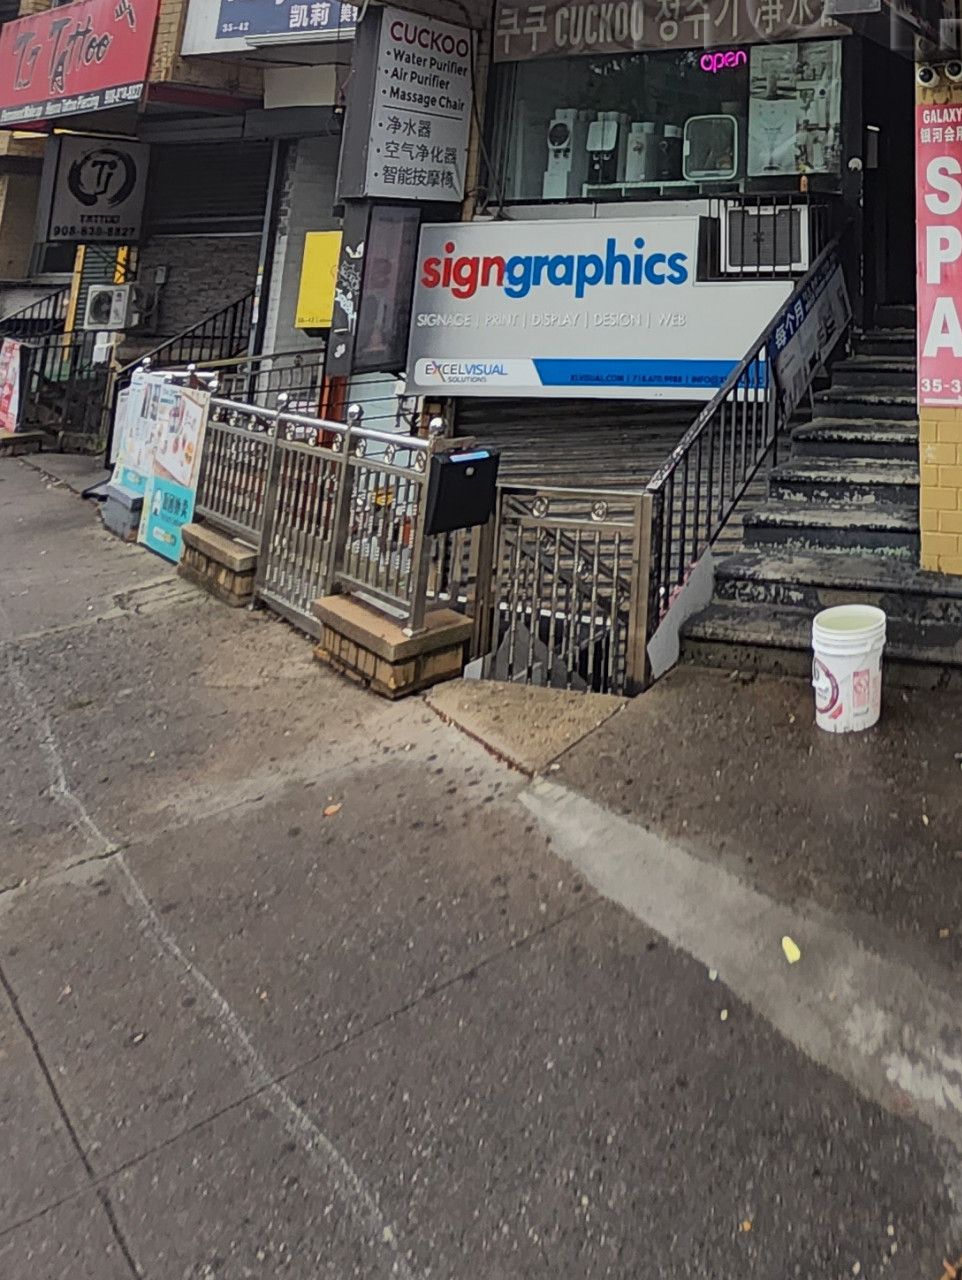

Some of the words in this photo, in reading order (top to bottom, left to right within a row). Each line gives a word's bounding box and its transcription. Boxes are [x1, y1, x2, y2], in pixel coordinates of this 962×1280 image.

[289, 2, 331, 29] 凯莉
[554, 0, 646, 48] CUCKOO
[390, 21, 470, 58] CUCKOO
[393, 47, 428, 68] Water
[429, 56, 469, 78] Purifier
[390, 66, 408, 82] Air
[410, 71, 451, 91] Purifier
[389, 85, 438, 109] Massage
[438, 95, 466, 113] Chair
[386, 115, 432, 139] 净水器
[922, 107, 962, 124] GALAXY
[383, 140, 458, 165] 空气净化器
[421, 237, 688, 299] signgraphics
[416, 312, 472, 327] SIGNAGE
[485, 312, 517, 327] PRINT
[531, 312, 581, 327] DISPLAY
[594, 312, 641, 327] DESIGN
[658, 312, 687, 327] WEB
[425, 361, 509, 379] EXCELVISUAL
[446, 376, 487, 384] SOLUTIONS
